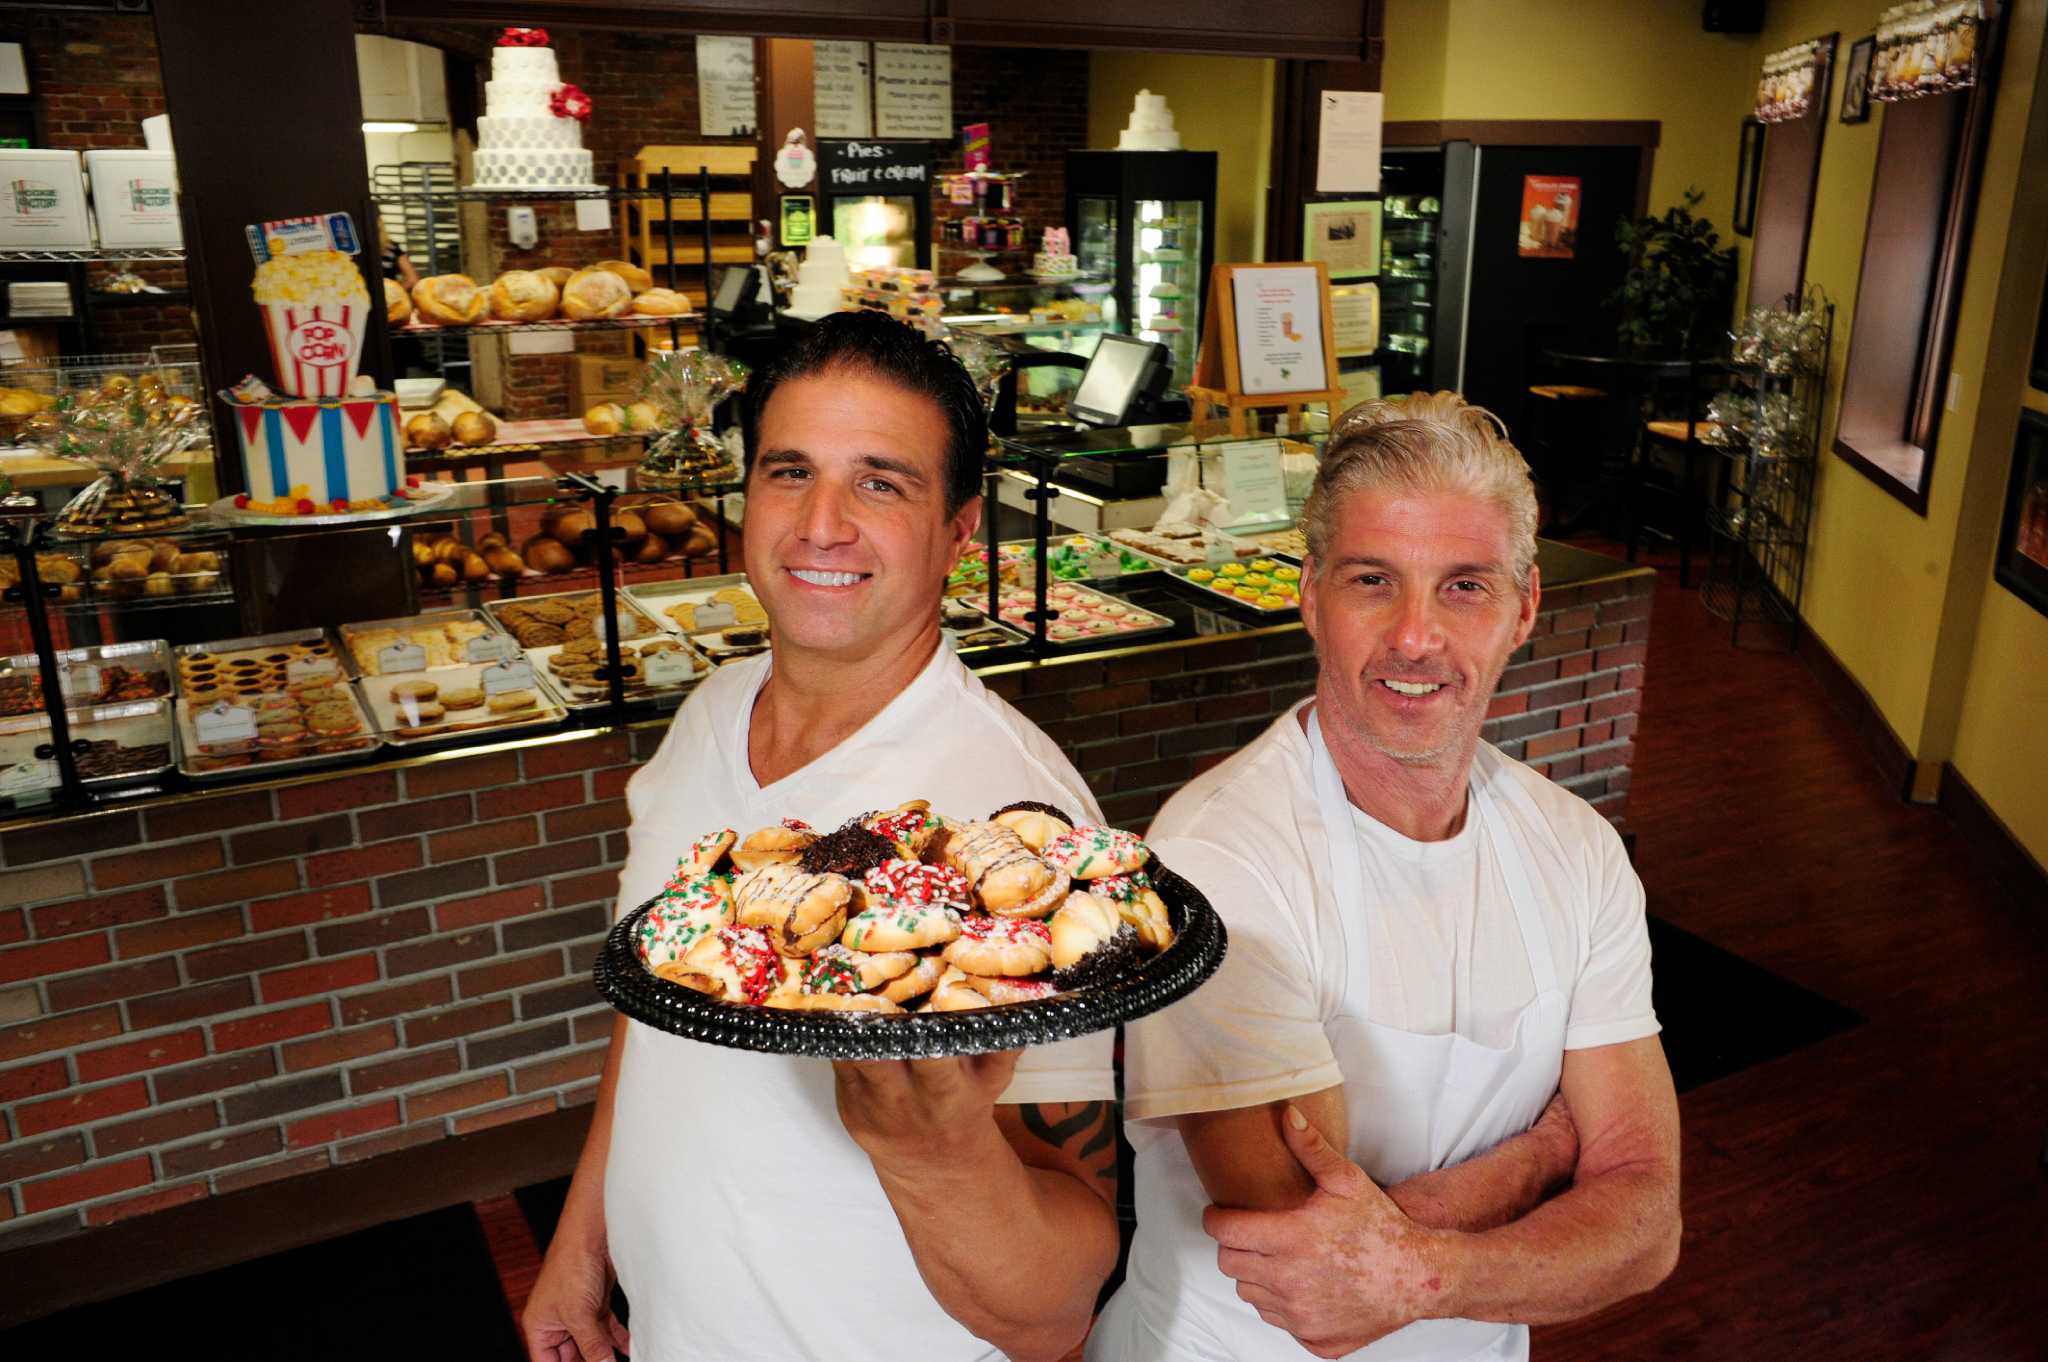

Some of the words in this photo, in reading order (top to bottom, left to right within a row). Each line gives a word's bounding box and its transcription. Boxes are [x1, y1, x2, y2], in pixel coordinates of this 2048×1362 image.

[847, 142, 884, 158] Pies
[303, 325, 336, 341] POP
[300, 343, 347, 361] CORN
